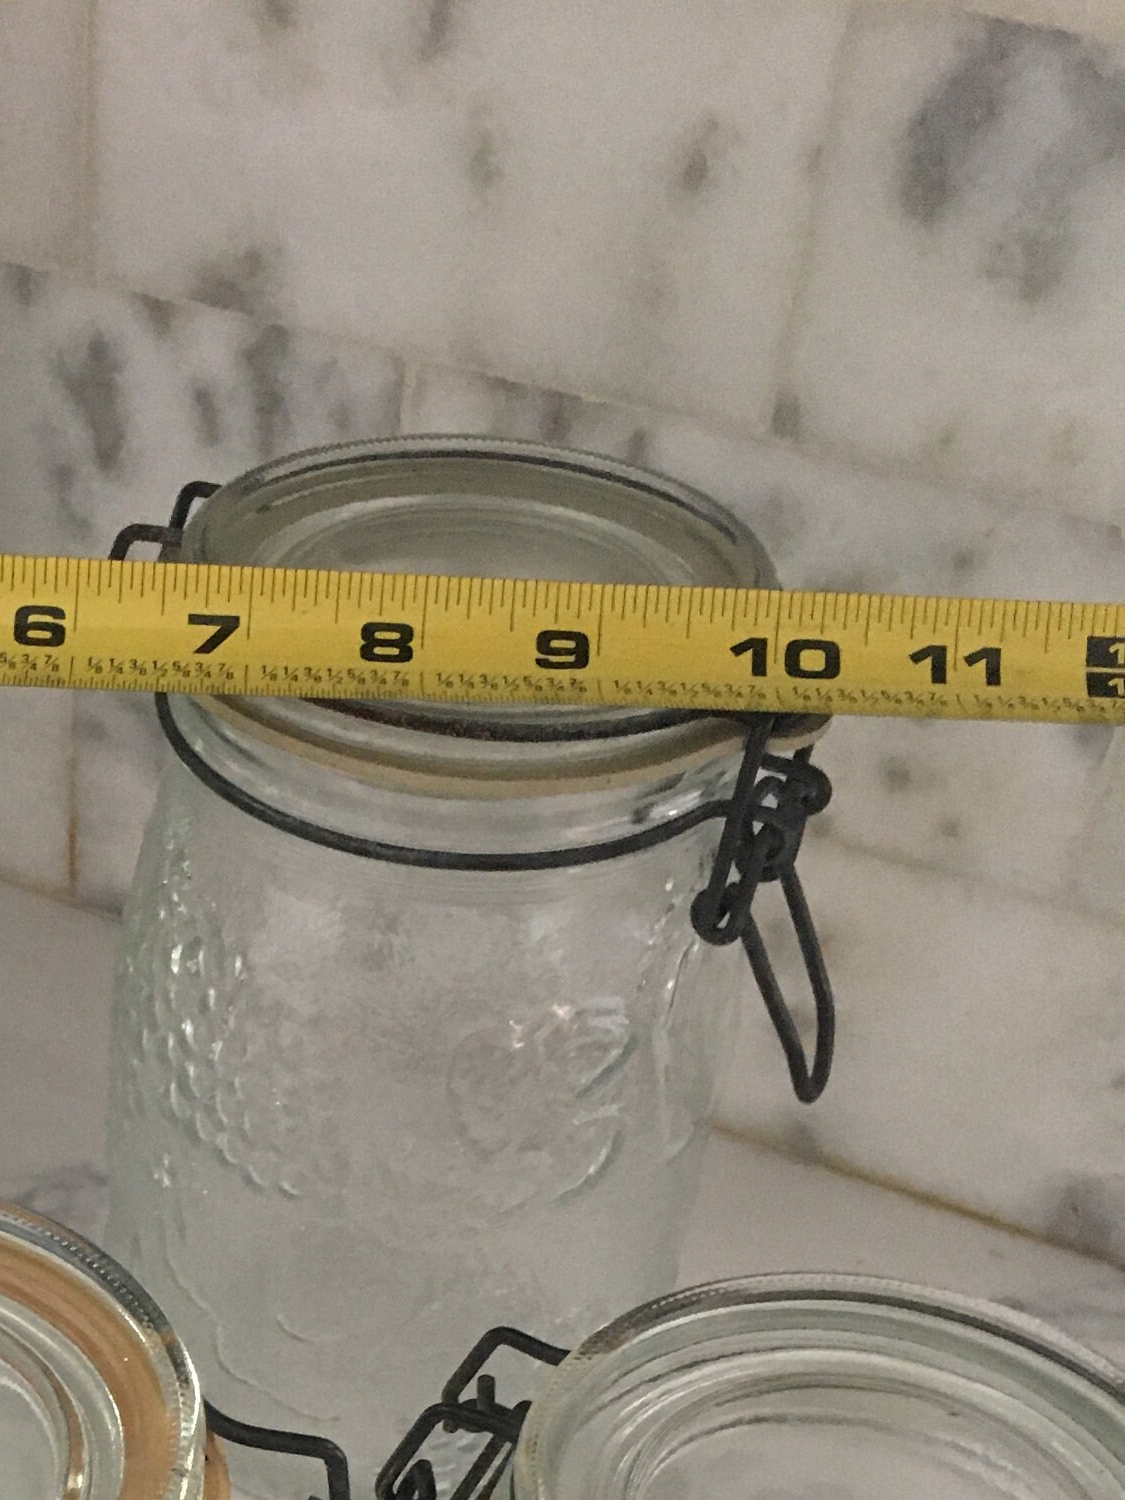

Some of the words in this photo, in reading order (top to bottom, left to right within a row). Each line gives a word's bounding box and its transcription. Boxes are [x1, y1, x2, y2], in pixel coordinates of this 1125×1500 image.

[13, 605, 66, 647] 6
[187, 613, 240, 654] 7
[360, 621, 415, 664] 8
[535, 629, 590, 670] 9
[729, 637, 841, 680] 10
[909, 645, 1002, 687] 11
